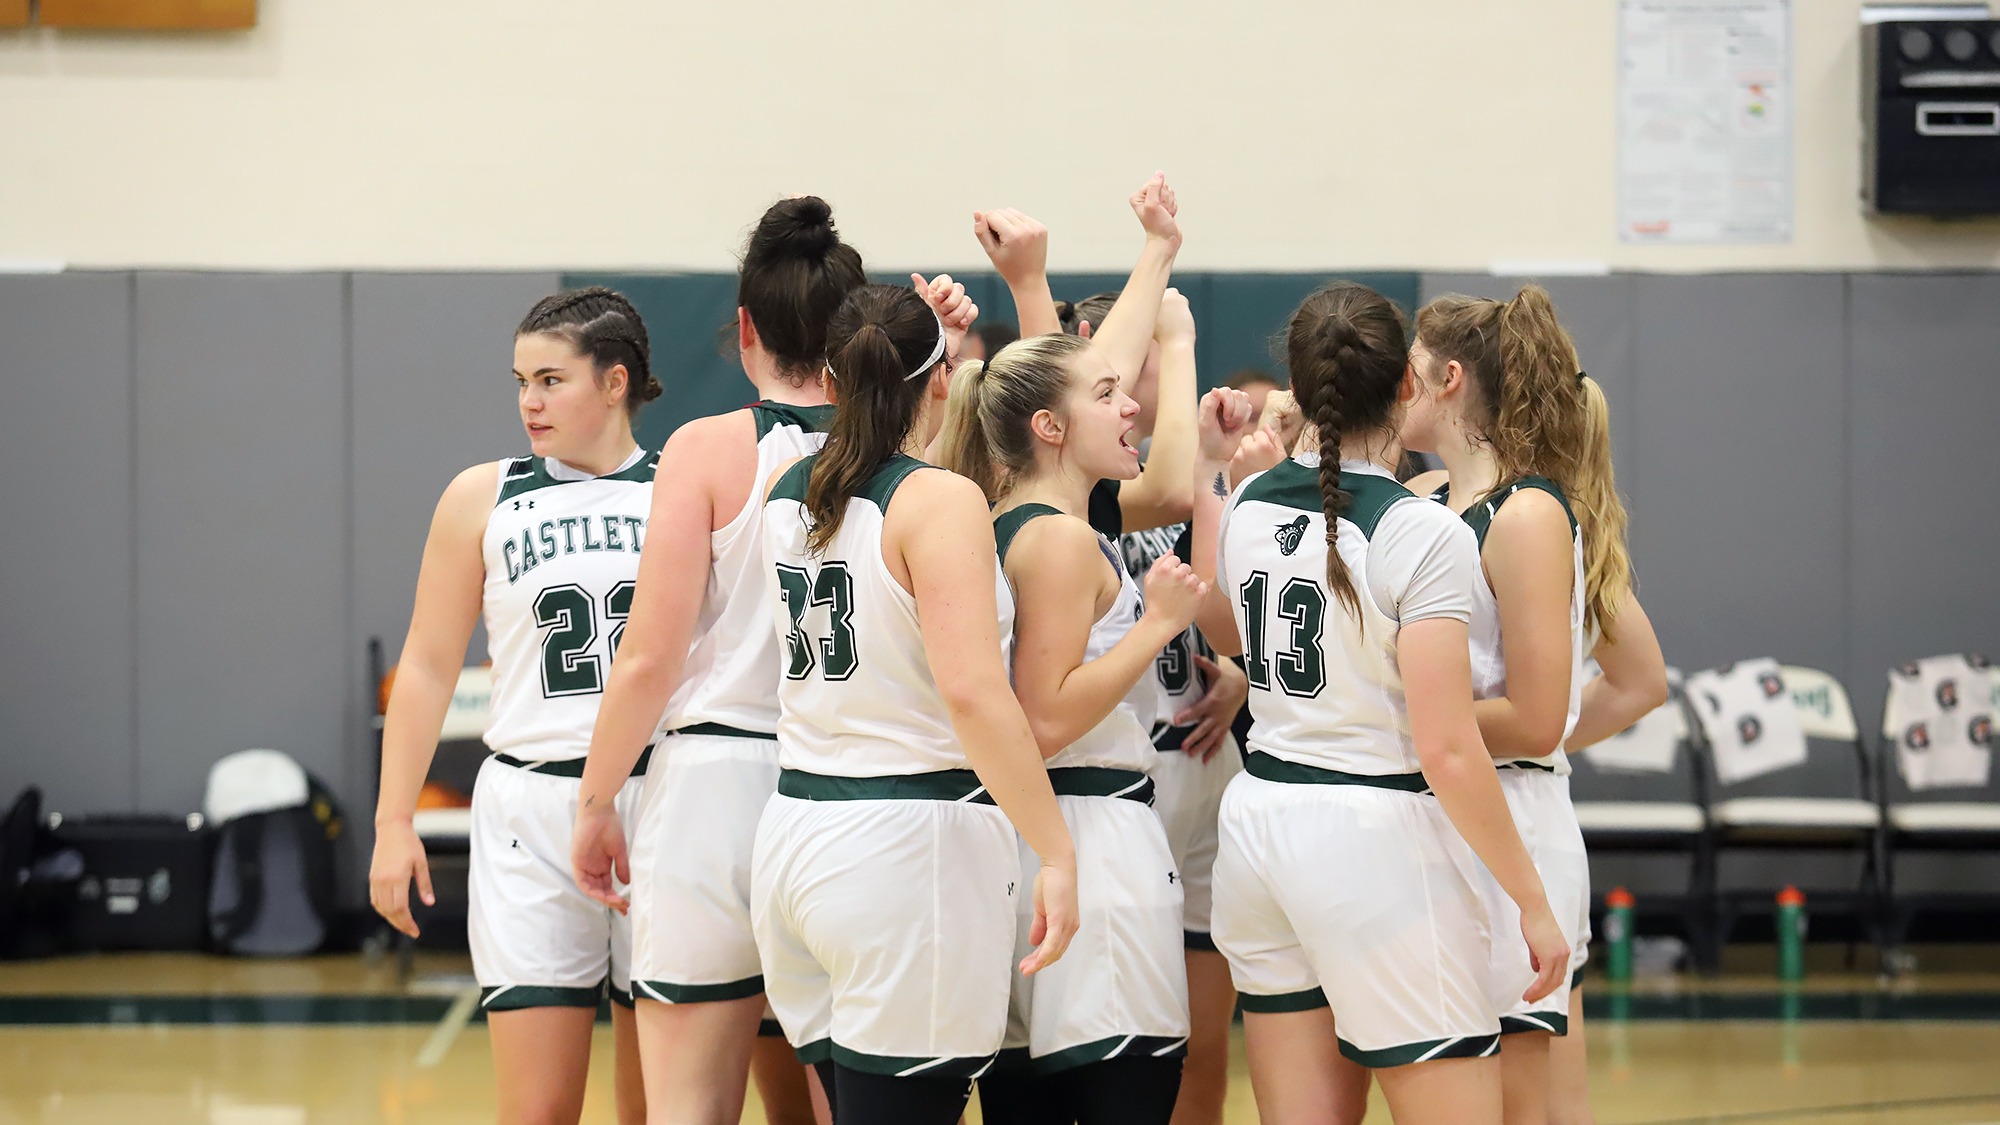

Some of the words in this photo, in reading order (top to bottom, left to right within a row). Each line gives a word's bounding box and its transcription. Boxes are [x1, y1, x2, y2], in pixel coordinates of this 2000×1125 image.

[503, 515, 650, 586] CASTLET
[776, 561, 859, 681] 33
[1239, 569, 1328, 699] 13
